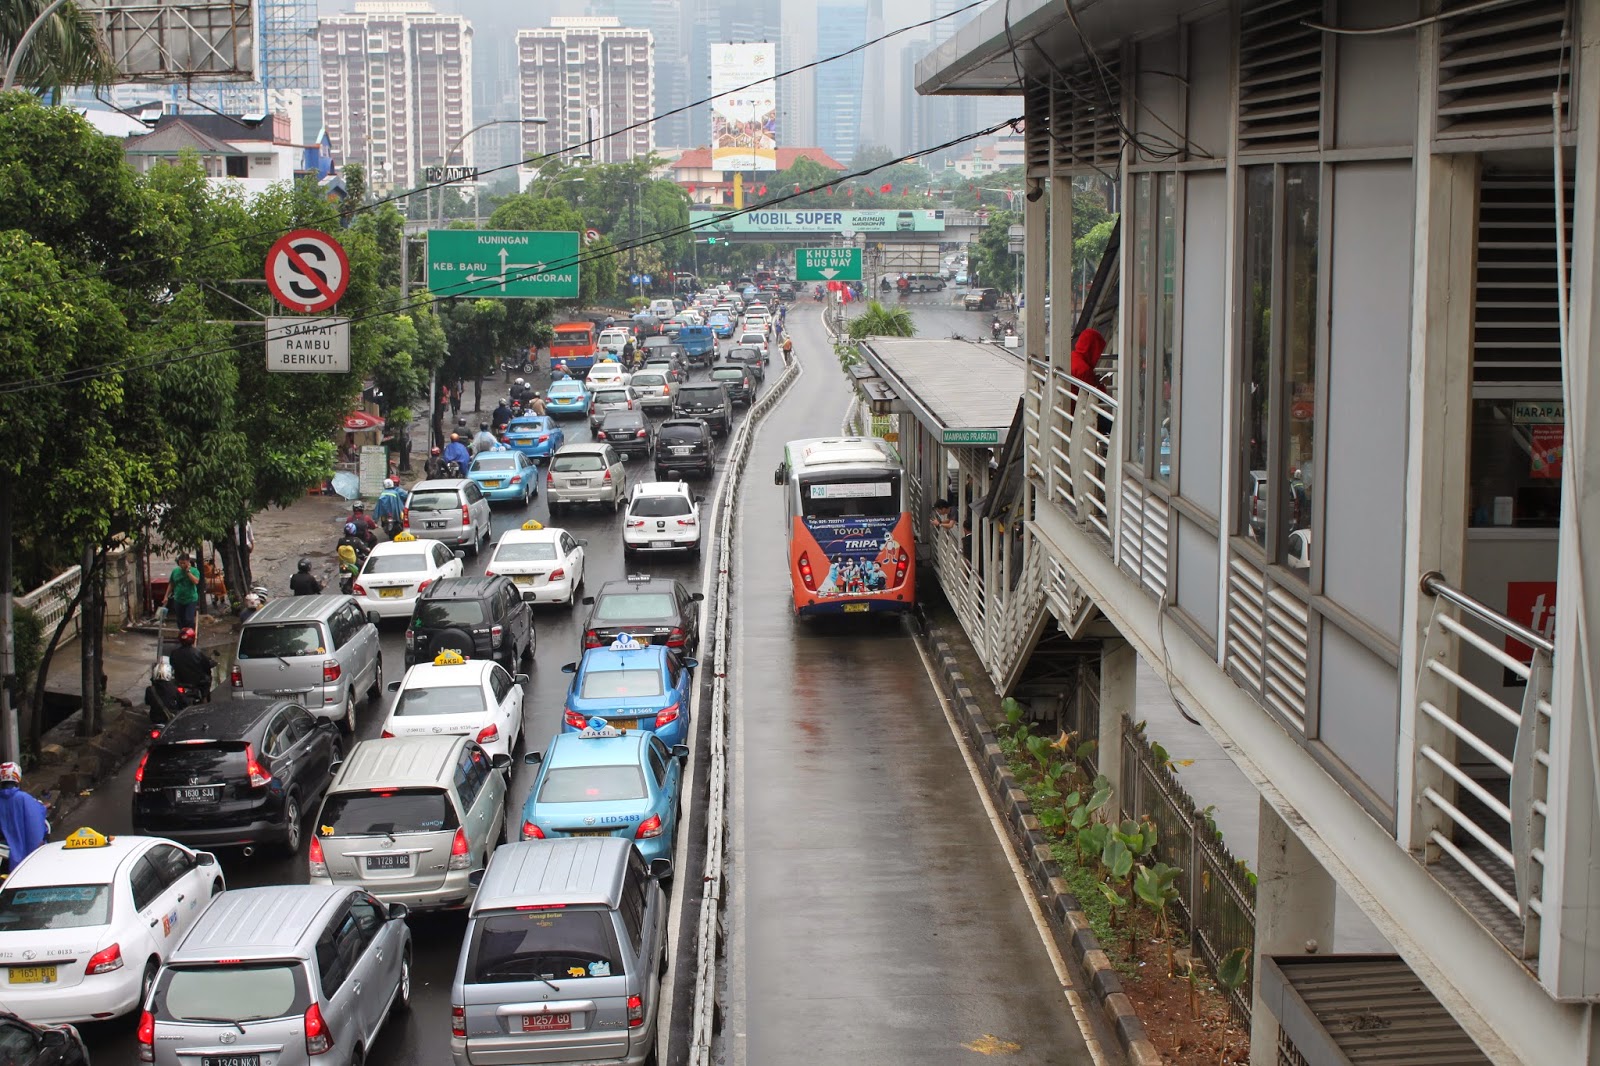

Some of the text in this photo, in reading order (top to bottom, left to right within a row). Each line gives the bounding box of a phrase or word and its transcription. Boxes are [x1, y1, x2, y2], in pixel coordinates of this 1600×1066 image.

[428, 168, 475, 181] PICADILLY
[748, 212, 842, 225] MOBIL SUPER
[477, 235, 529, 245] KUNINGAN
[806, 250, 852, 258] KHUSUS
[433, 262, 487, 271] KEB. BARU
[806, 258, 851, 267] BUS WAY
[516, 273, 572, 283] PANCORAN
[286, 340, 330, 350] RAMBU
[283, 354, 334, 364] BERIKUT
[944, 432, 996, 441] MAMPANG PRAPATAN
[845, 540, 878, 548] TRIPA
[176, 790, 181, 798] B
[600, 814, 640, 824] LED 5483
[70, 837, 97, 846] TAKSI
[367, 857, 372, 866] B
[9, 969, 15, 978] B
[19, 968, 38, 978] 1651
[522, 1016, 530, 1026] B
[532, 1014, 554, 1025] 1257
[241, 1056, 257, 1066] NKX
